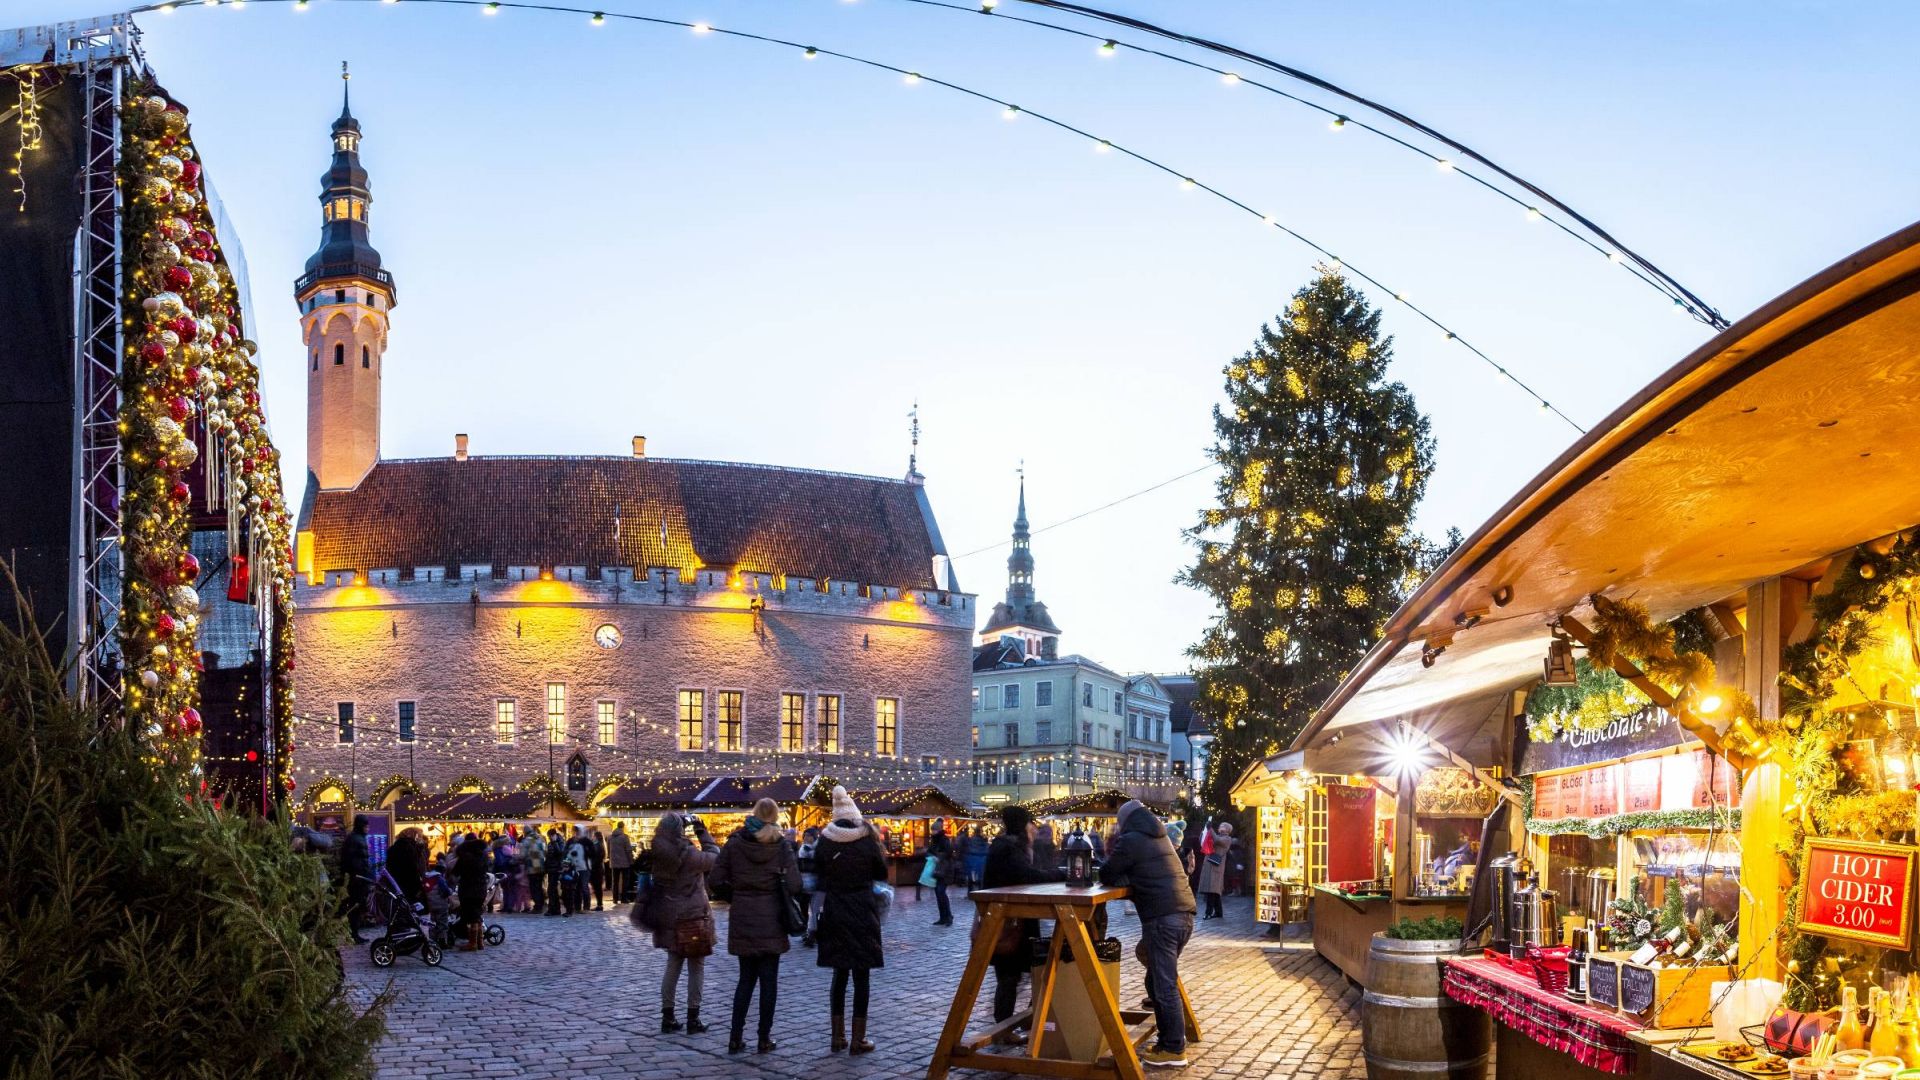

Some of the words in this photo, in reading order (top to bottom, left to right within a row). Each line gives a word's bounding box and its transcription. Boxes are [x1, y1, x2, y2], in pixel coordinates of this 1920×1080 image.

[1831, 854, 1888, 879] HOT
[1821, 878, 1893, 907] CIDER
[1833, 903, 1875, 929] 3.00
